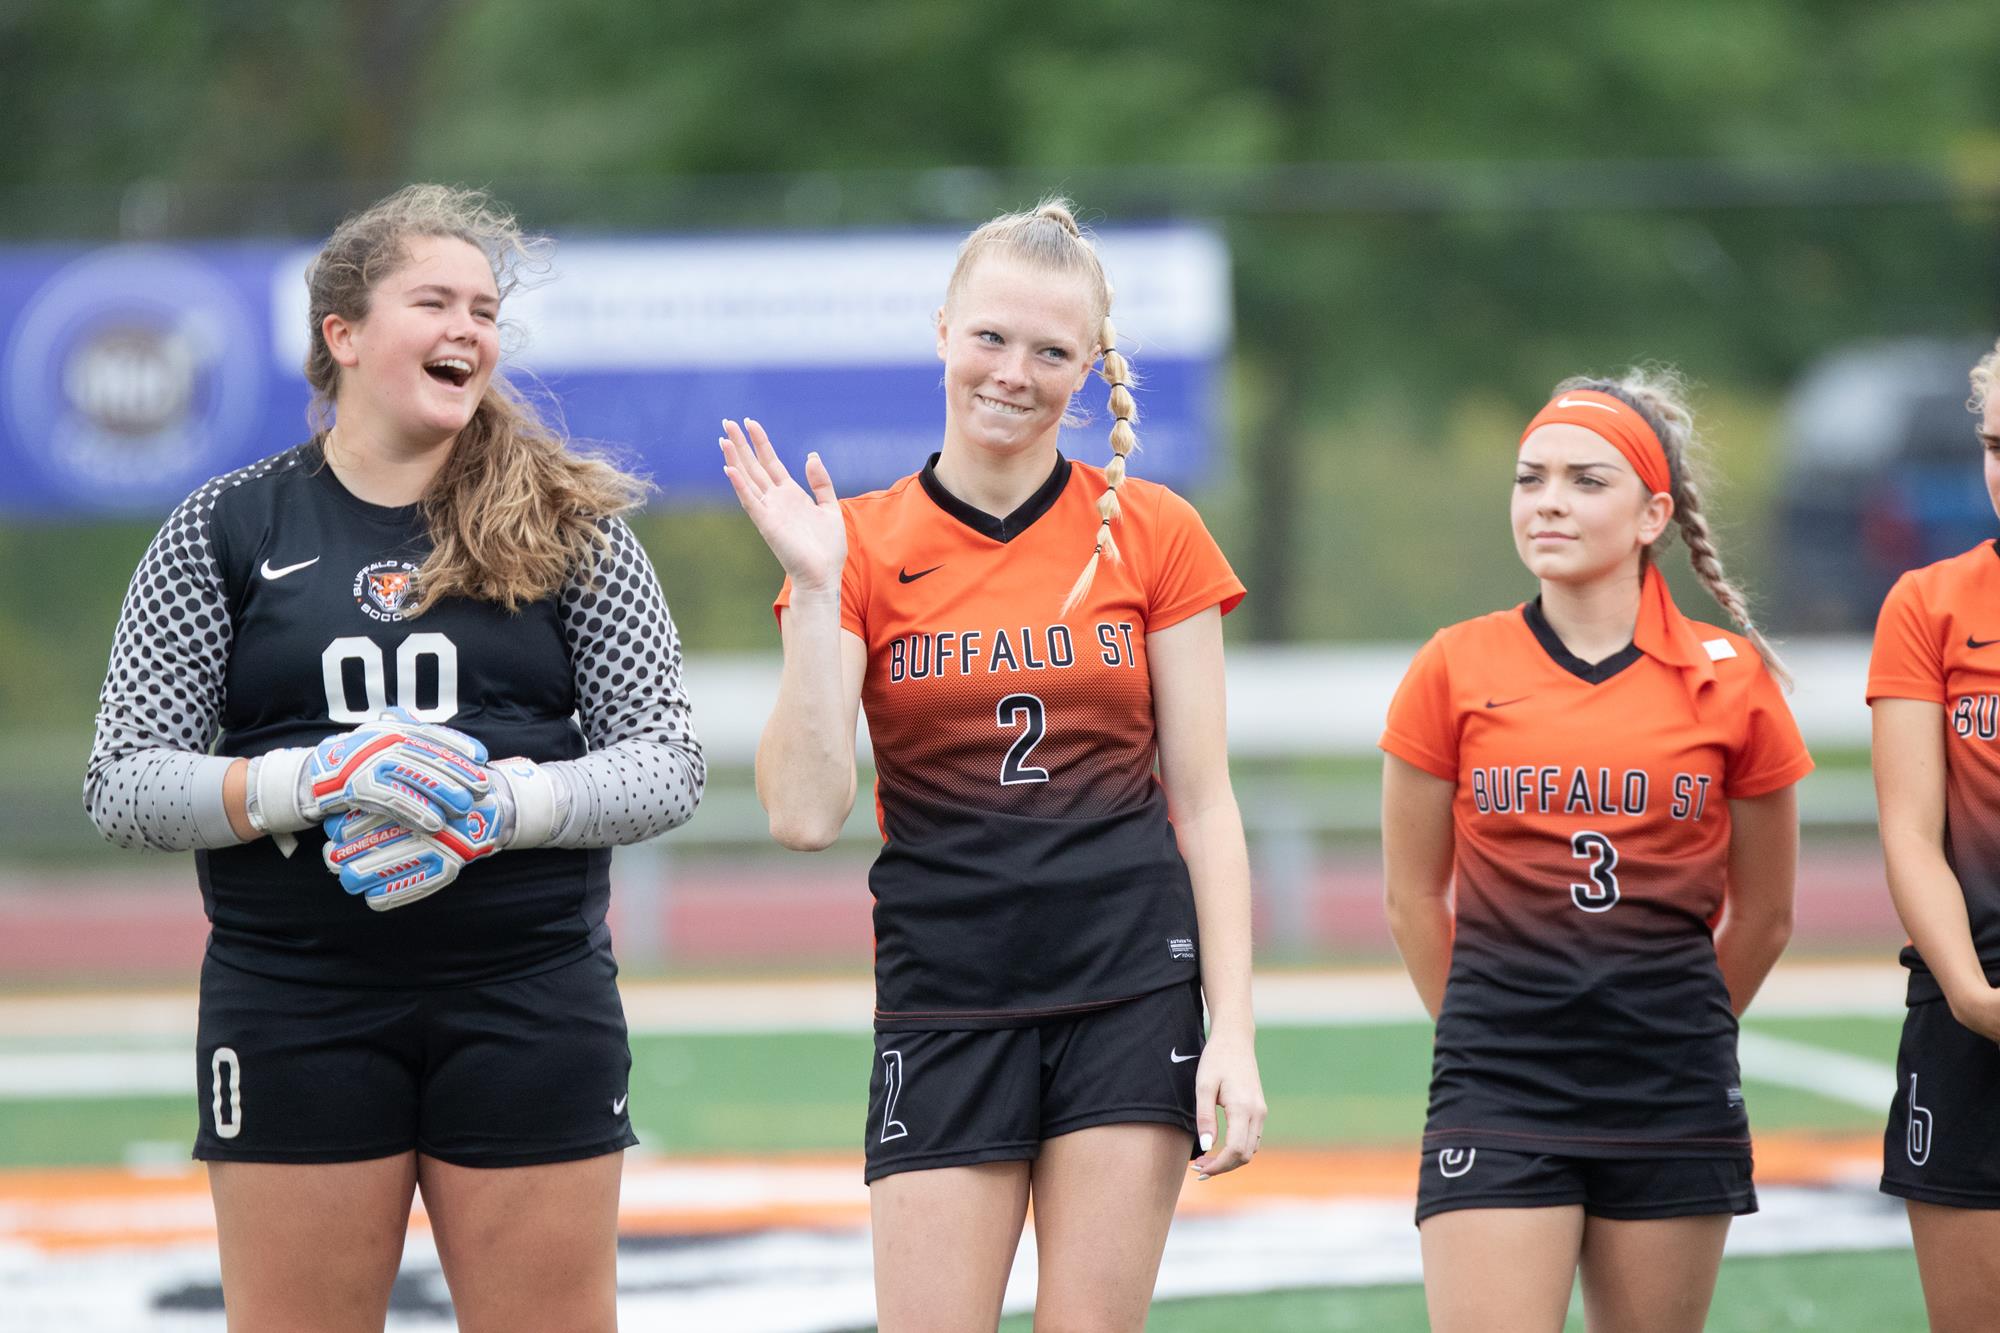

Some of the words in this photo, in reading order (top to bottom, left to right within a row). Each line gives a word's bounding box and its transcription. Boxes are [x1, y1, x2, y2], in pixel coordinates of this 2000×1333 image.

[353, 560, 398, 596] BUFFALO
[322, 632, 458, 723] 00
[889, 624, 1075, 683] BUFFALO
[1097, 622, 1135, 668] ST
[996, 692, 1049, 786] 2
[1472, 766, 1649, 817] BUFFALO
[1671, 773, 1712, 821] ST
[1570, 830, 1620, 913] 3
[212, 1047, 242, 1139] 0
[1907, 1072, 1933, 1166] 6
